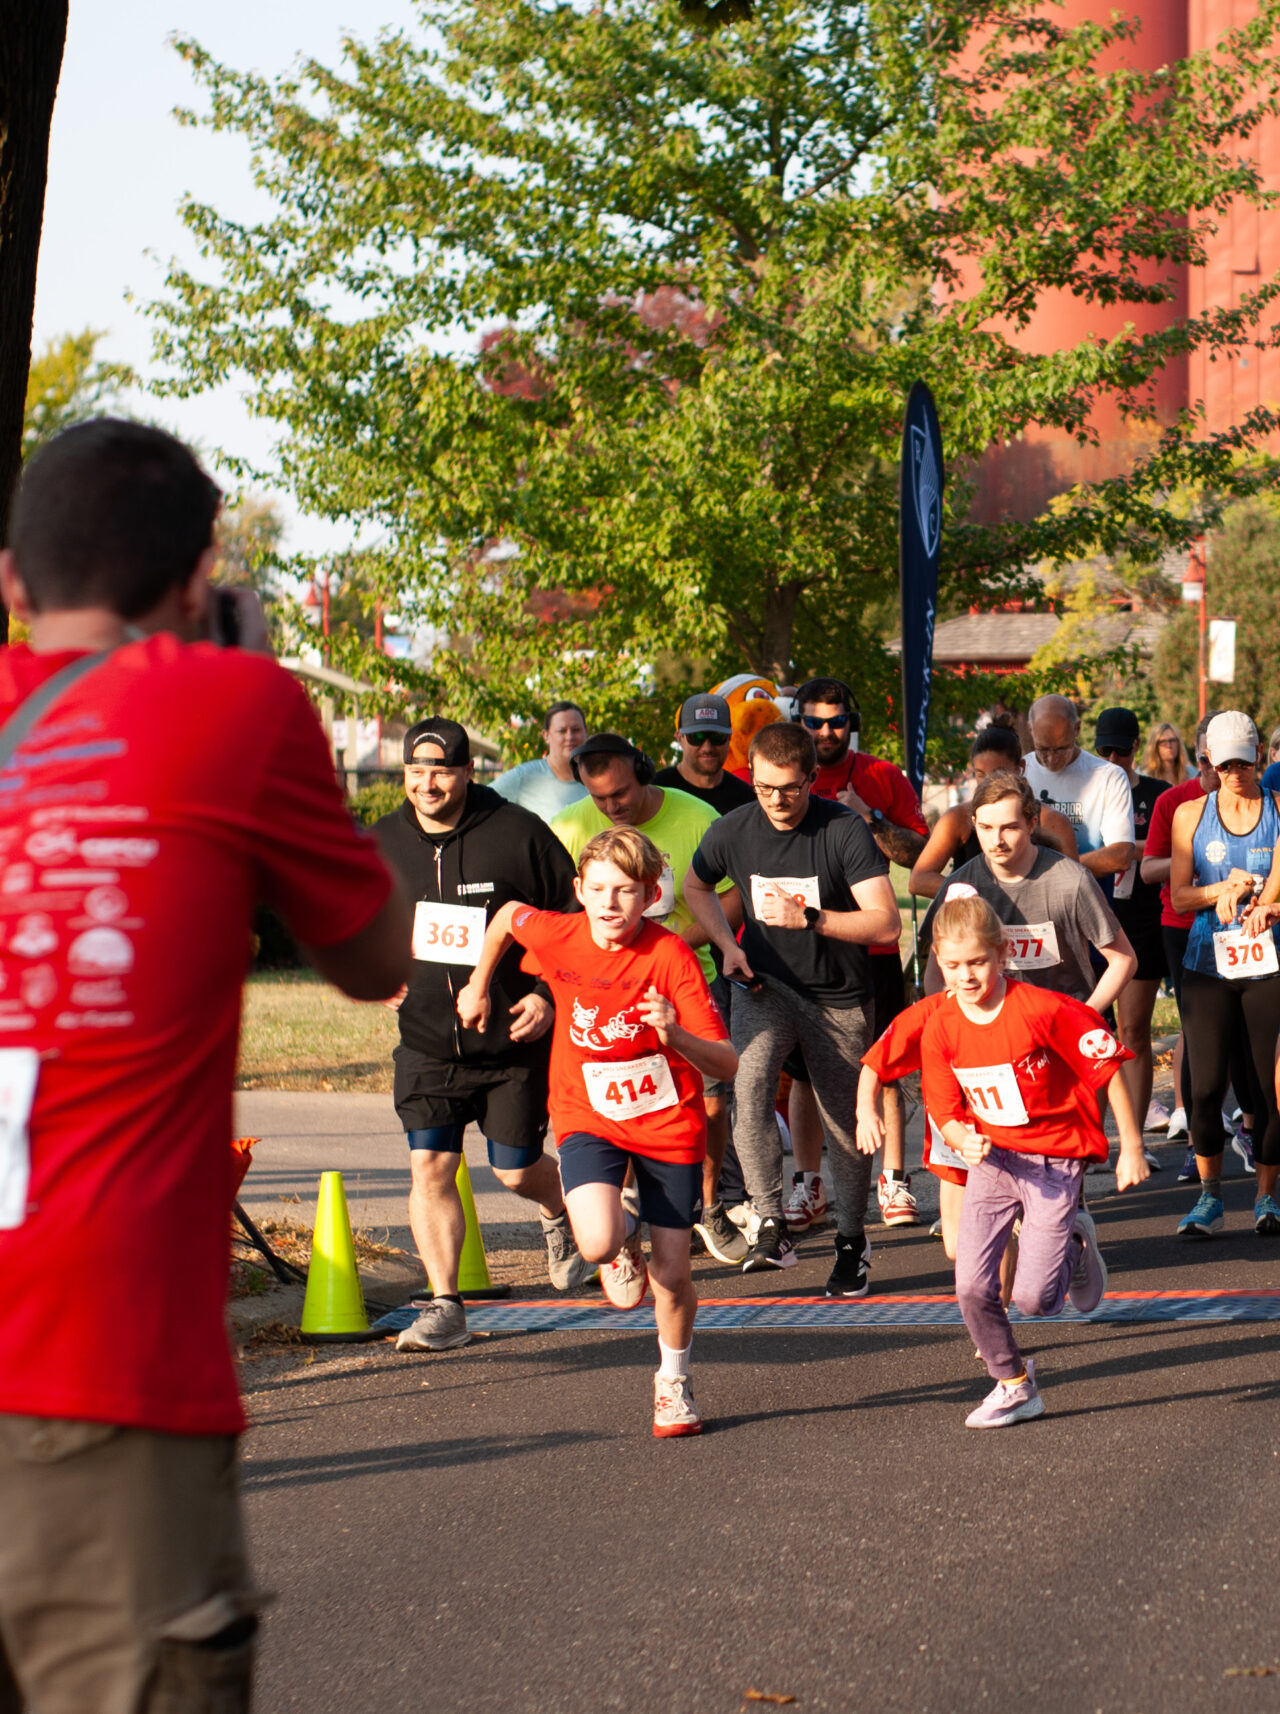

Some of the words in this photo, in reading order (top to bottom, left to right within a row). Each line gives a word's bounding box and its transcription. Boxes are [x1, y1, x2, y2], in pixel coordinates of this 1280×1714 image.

[426, 921, 469, 949] 363
[1226, 943, 1264, 966] 370
[605, 1074, 658, 1105] 414
